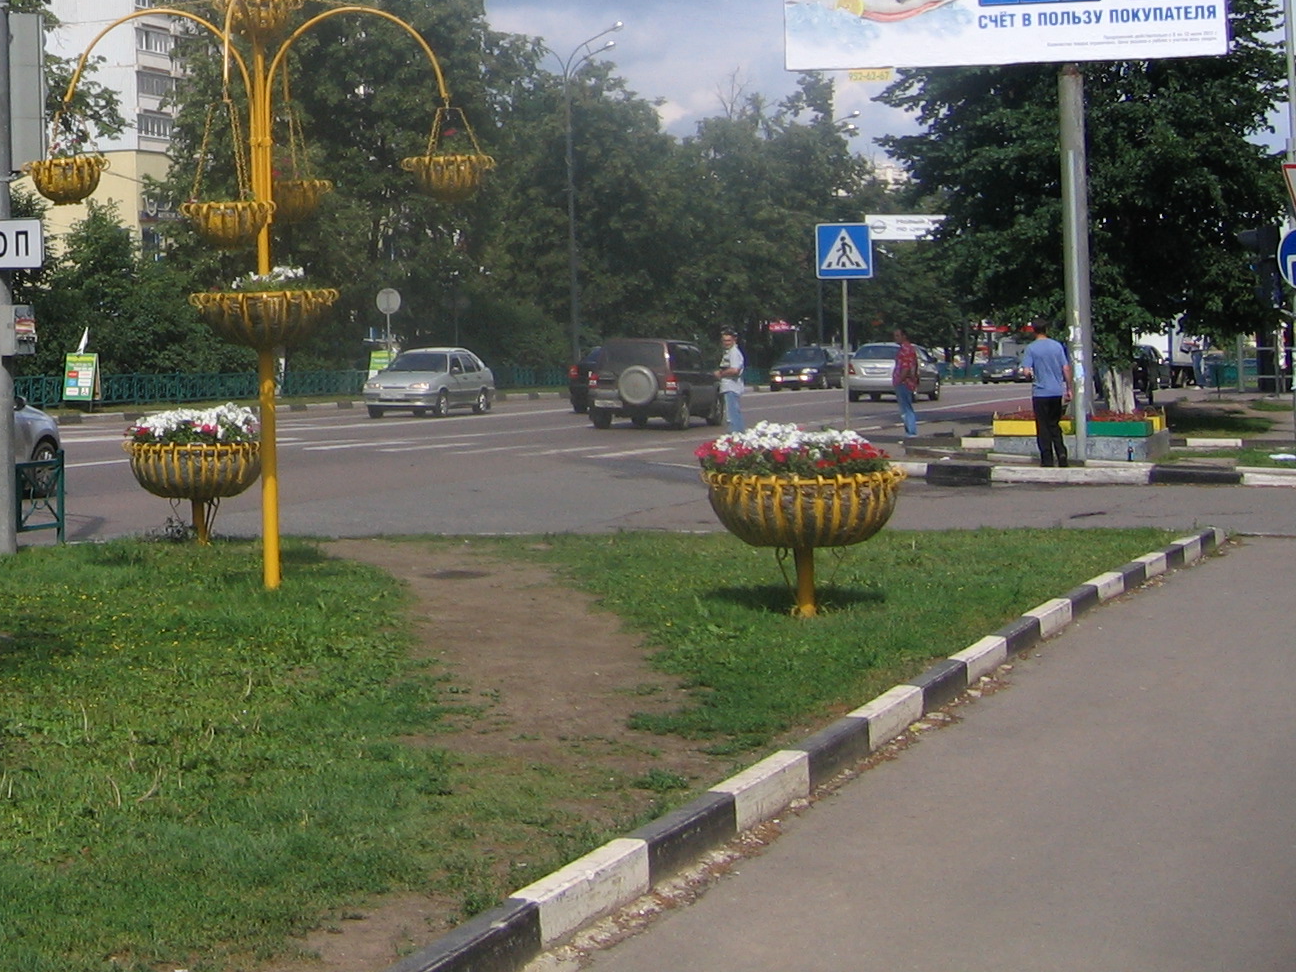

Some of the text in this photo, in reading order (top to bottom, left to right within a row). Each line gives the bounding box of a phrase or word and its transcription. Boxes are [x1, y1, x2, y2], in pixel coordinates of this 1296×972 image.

[979, 5, 1217, 29] СЧЁТ В ПОЛЬЗУ ПОКУПАТЕЛЯ
